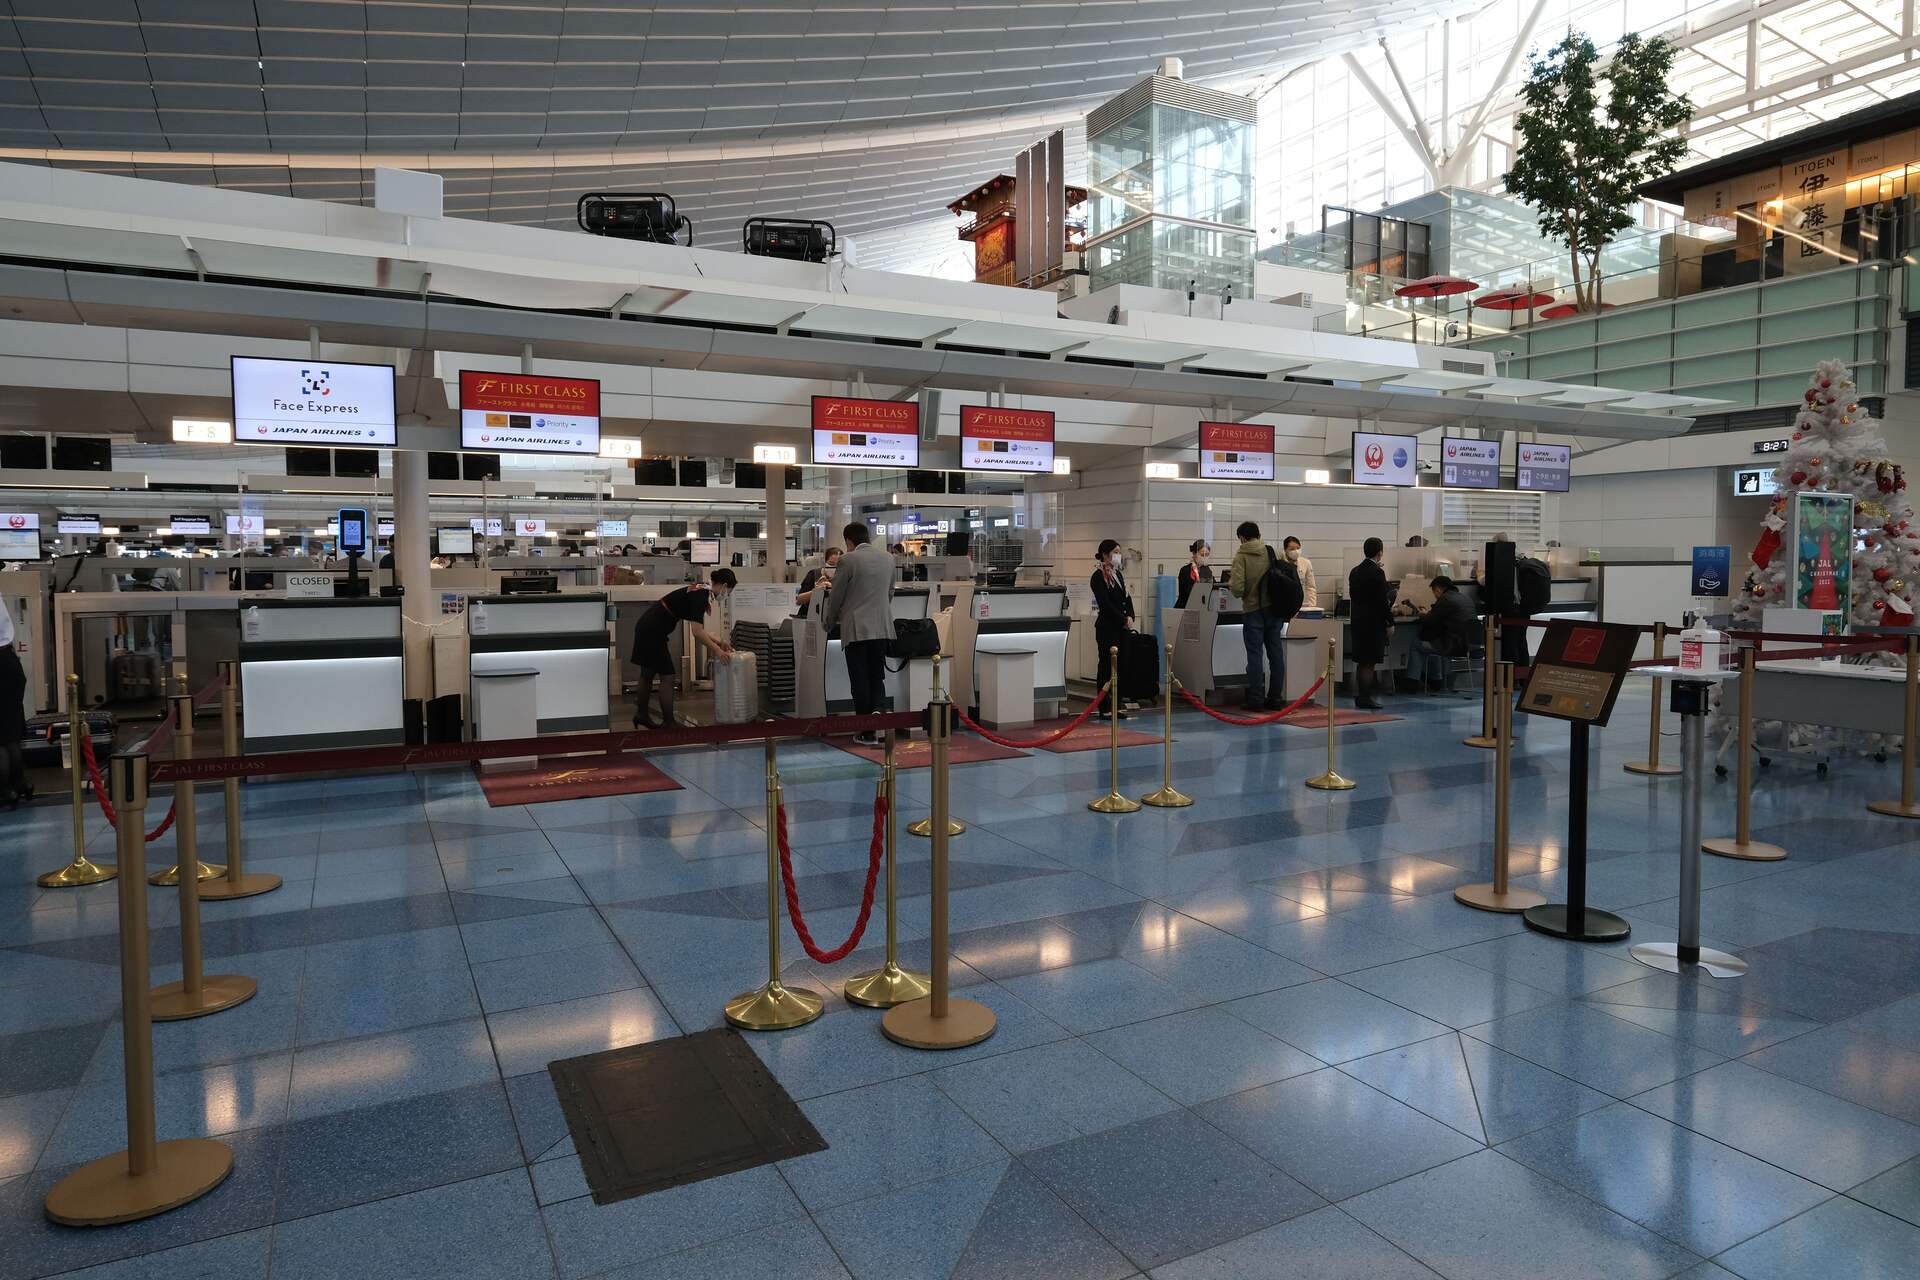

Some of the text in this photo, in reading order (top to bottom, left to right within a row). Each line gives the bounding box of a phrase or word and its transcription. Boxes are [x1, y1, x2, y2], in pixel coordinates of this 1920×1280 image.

[1794, 156, 1835, 176] ITOEN
[1798, 173, 1829, 258] 伊藤園
[501, 382, 540, 396] FIRST
[544, 385, 586, 398] CLASS
[273, 399, 359, 414] Face Express
[843, 406, 872, 416] FIRST
[876, 408, 909, 419] CLASS
[988, 414, 1015, 425] FIRST
[1016, 416, 1046, 427] CLASS
[311, 428, 362, 436] AIRLINES
[1221, 429, 1242, 439] FIRST
[1244, 430, 1267, 440] CLASS
[1763, 441, 1787, 451] 8:27
[1818, 559, 1831, 567] JAL
[290, 576, 330, 586] CLOSED
[198, 763, 227, 773] FIRST
[231, 760, 266, 770] CLASS
